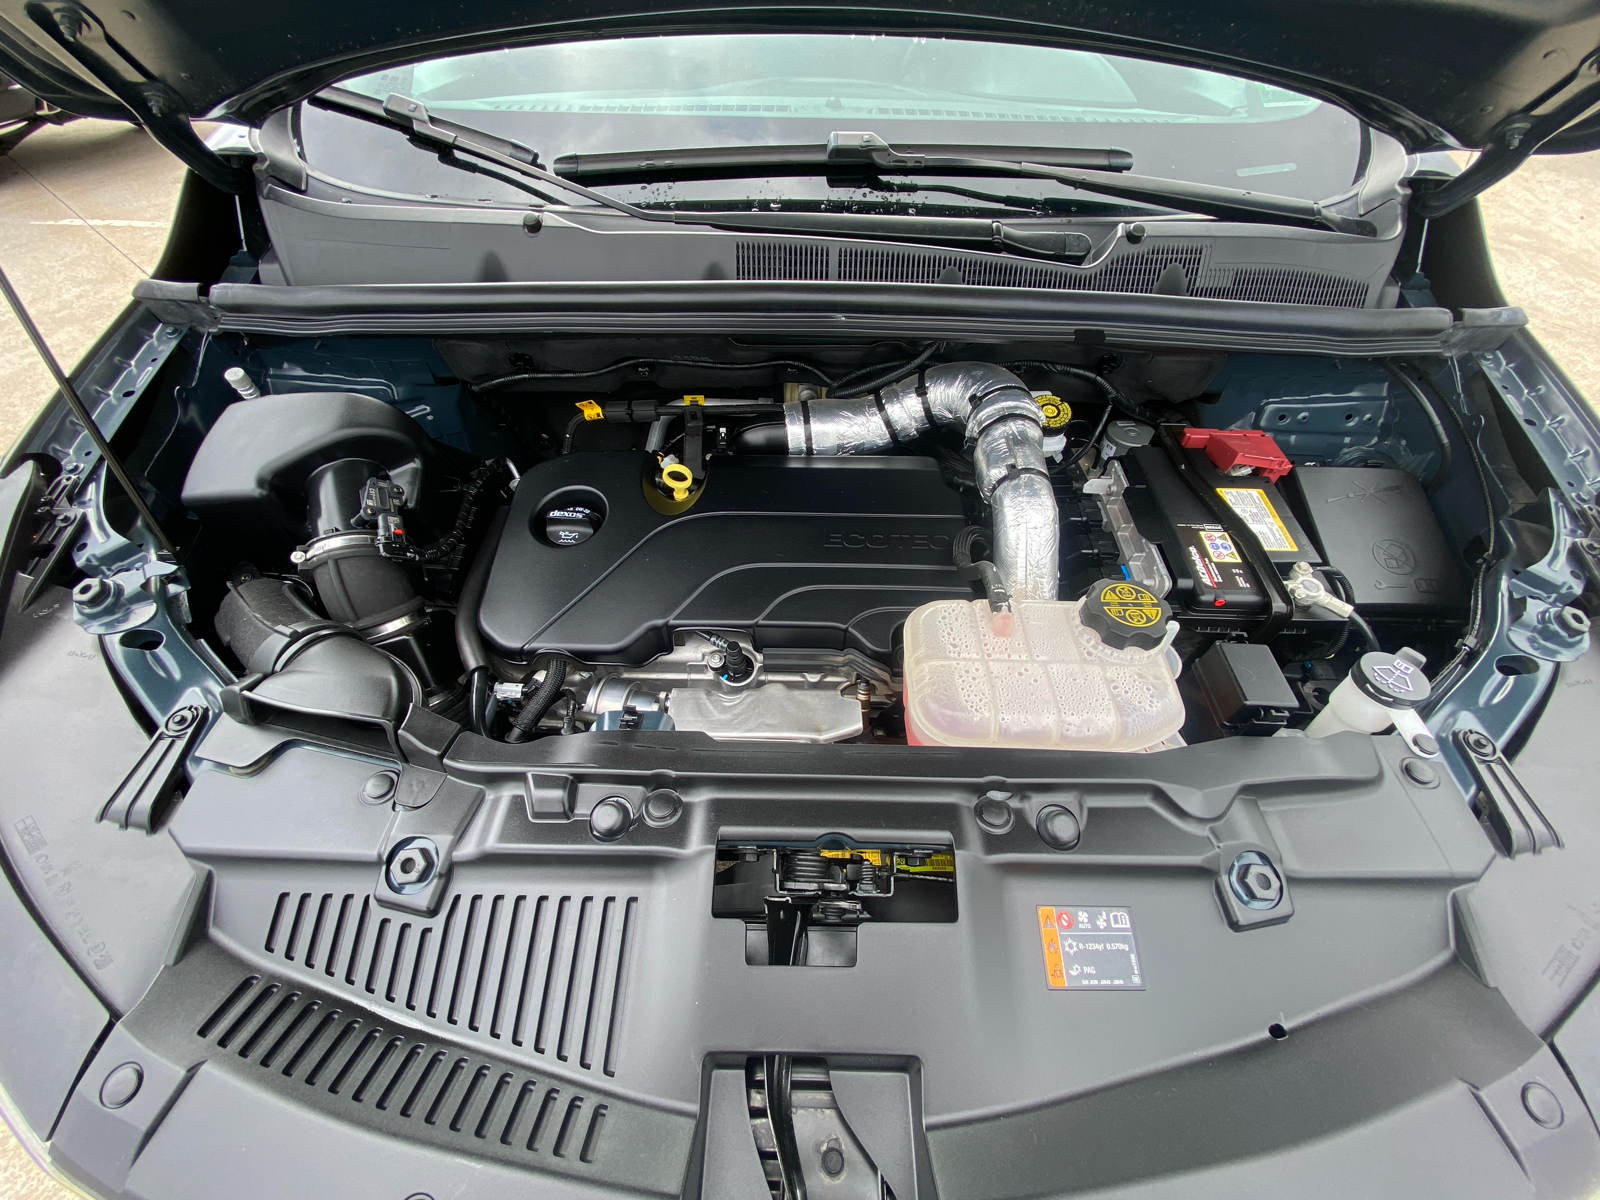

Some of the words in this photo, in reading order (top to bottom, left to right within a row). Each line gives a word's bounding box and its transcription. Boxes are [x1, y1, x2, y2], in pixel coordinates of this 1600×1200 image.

[550, 510, 586, 518] dexos
[823, 533, 950, 549] ECOTEC
[1079, 943, 1105, 951] R-1234yf
[1083, 966, 1096, 974] PAG
